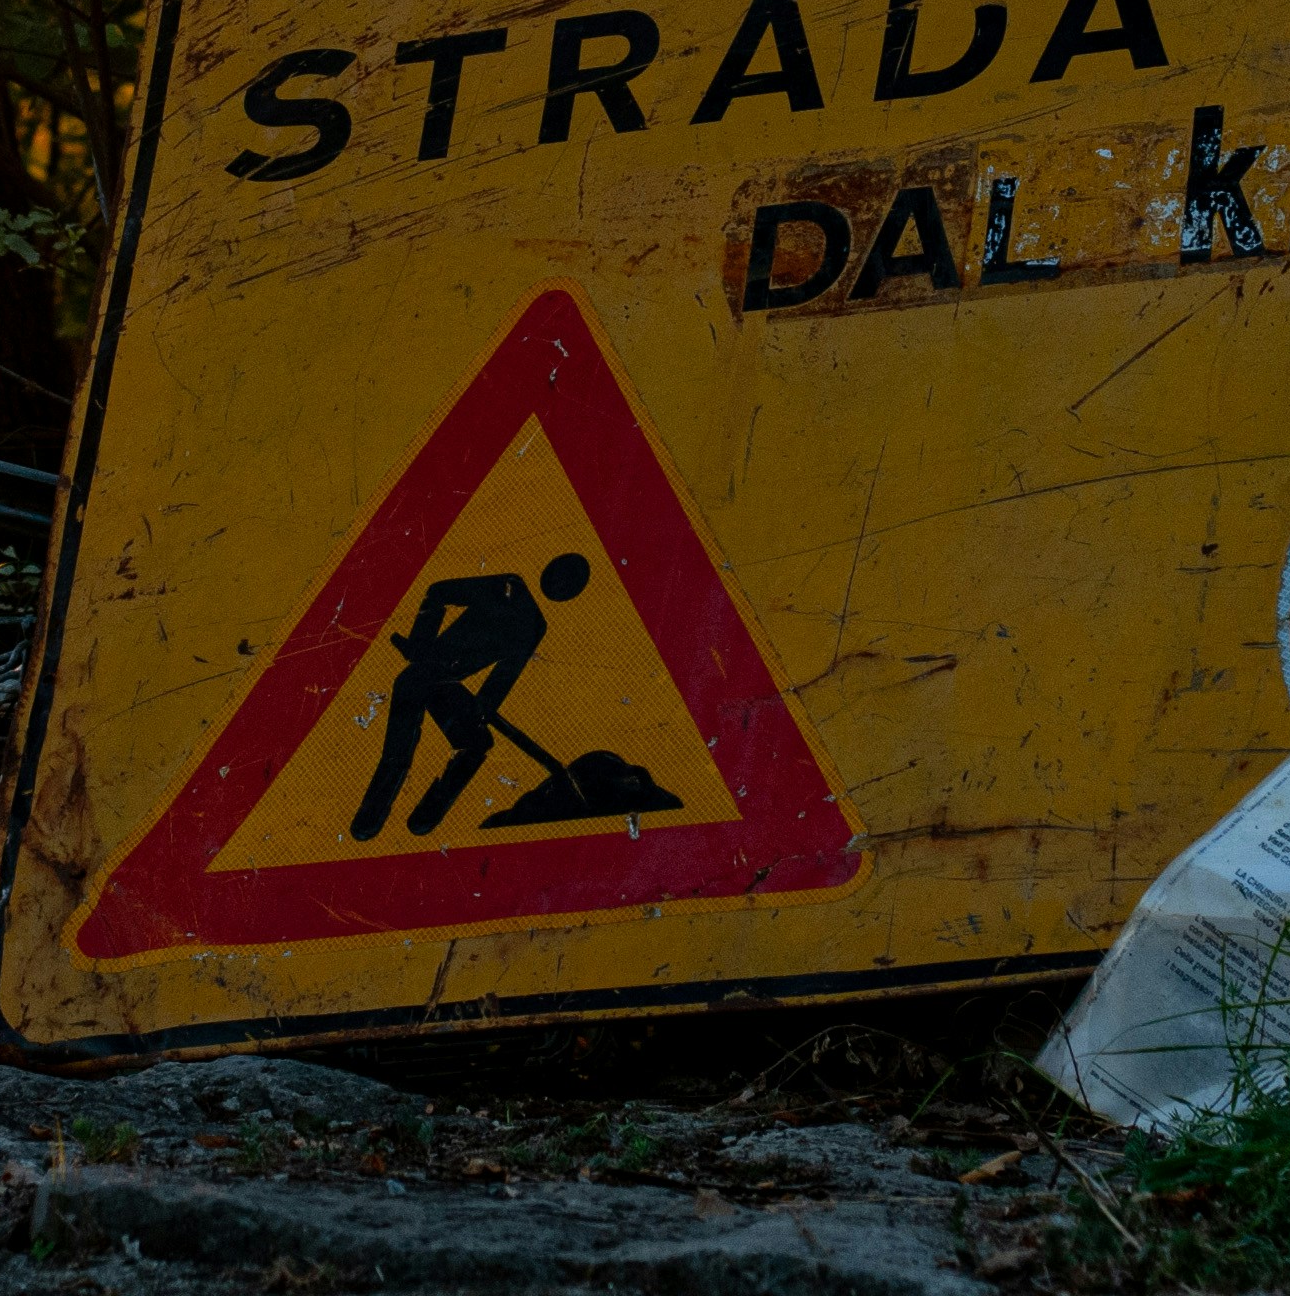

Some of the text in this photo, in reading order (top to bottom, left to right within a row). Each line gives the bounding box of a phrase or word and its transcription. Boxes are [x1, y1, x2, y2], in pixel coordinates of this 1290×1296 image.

[742, 175, 1061, 313] DAL
[1234, 868, 1247, 880] LA
[1246, 876, 1288, 911] CHIUSURA
[1253, 910, 1275, 928] SINO
